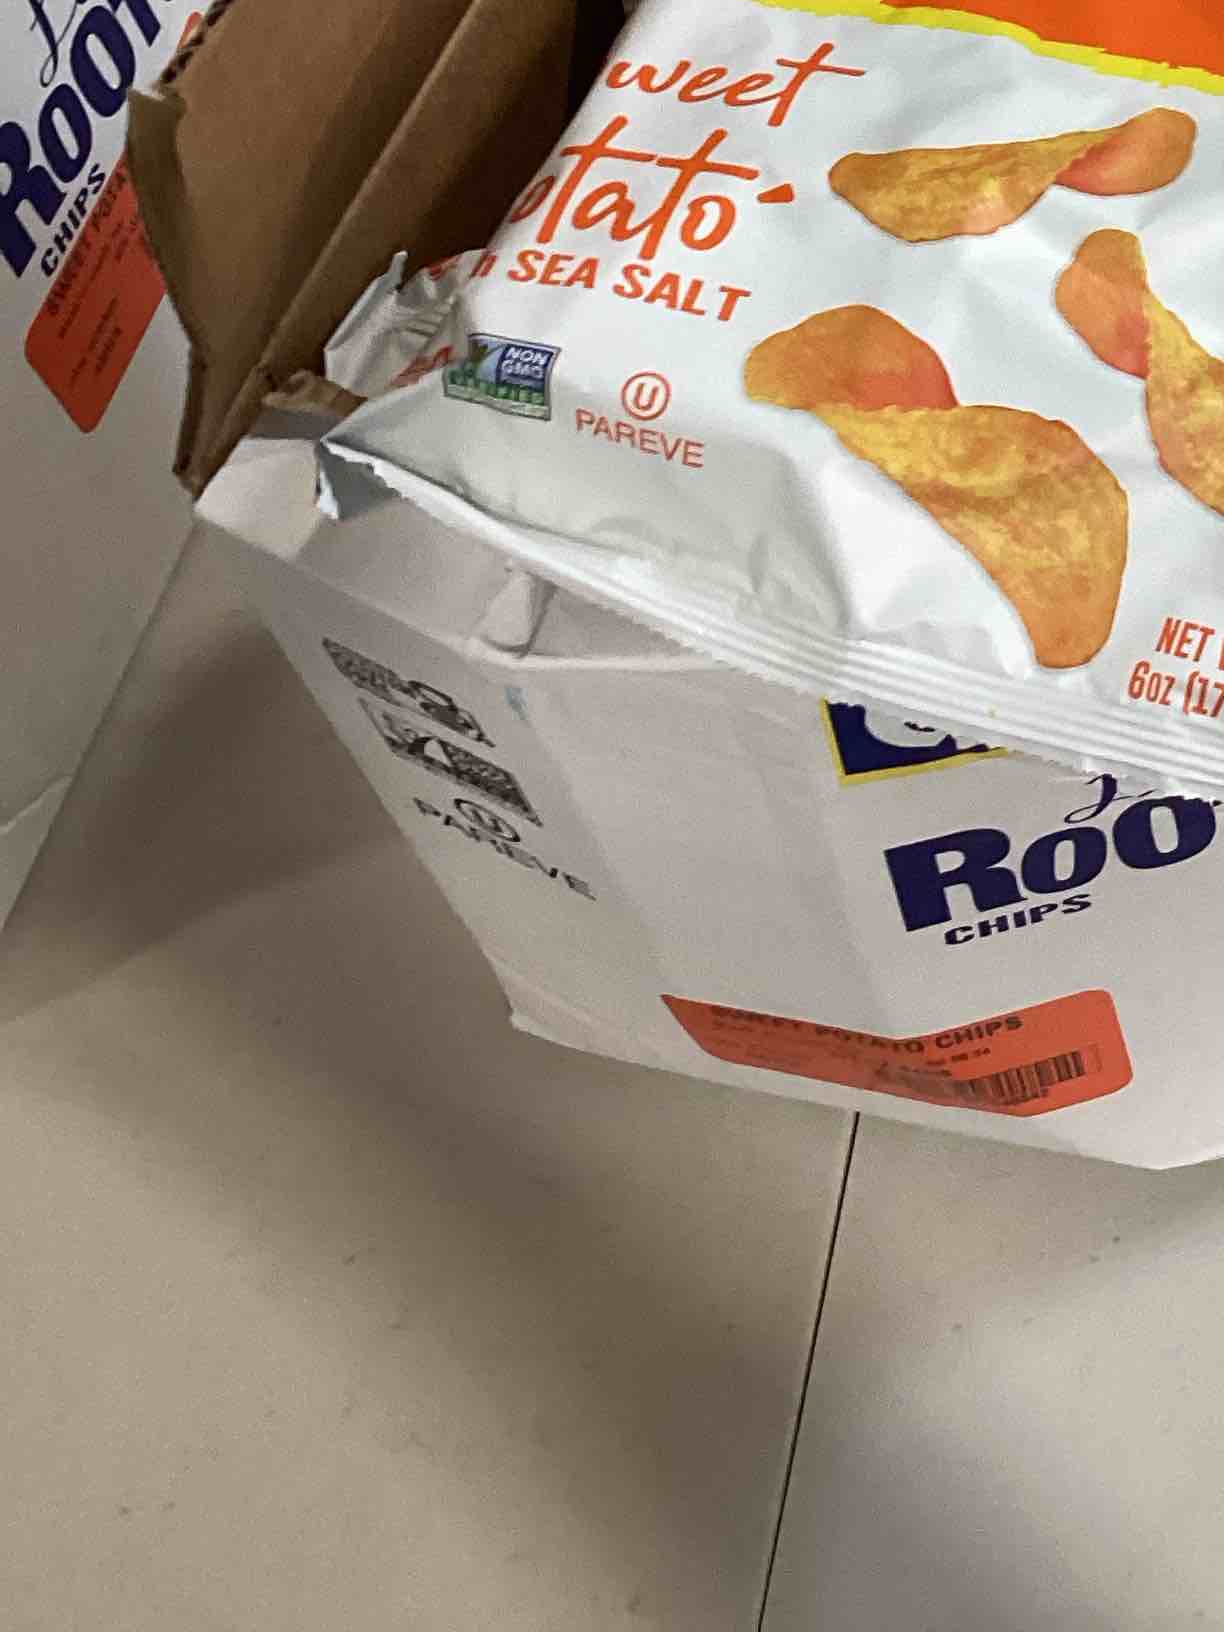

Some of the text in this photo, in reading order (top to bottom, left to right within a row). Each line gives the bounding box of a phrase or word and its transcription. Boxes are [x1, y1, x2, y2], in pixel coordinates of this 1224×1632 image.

[605, 42, 866, 127] weet
[40, 163, 106, 278] CHIPS
[507, 248, 601, 289] SEA
[612, 263, 752, 322] SALT
[505, 346, 548, 364] NON
[574, 408, 705, 469] PAREVE
[1155, 616, 1216, 662] NET
[943, 893, 1094, 947] CHIPS
[935, 1015, 1024, 1049] CHIPS
